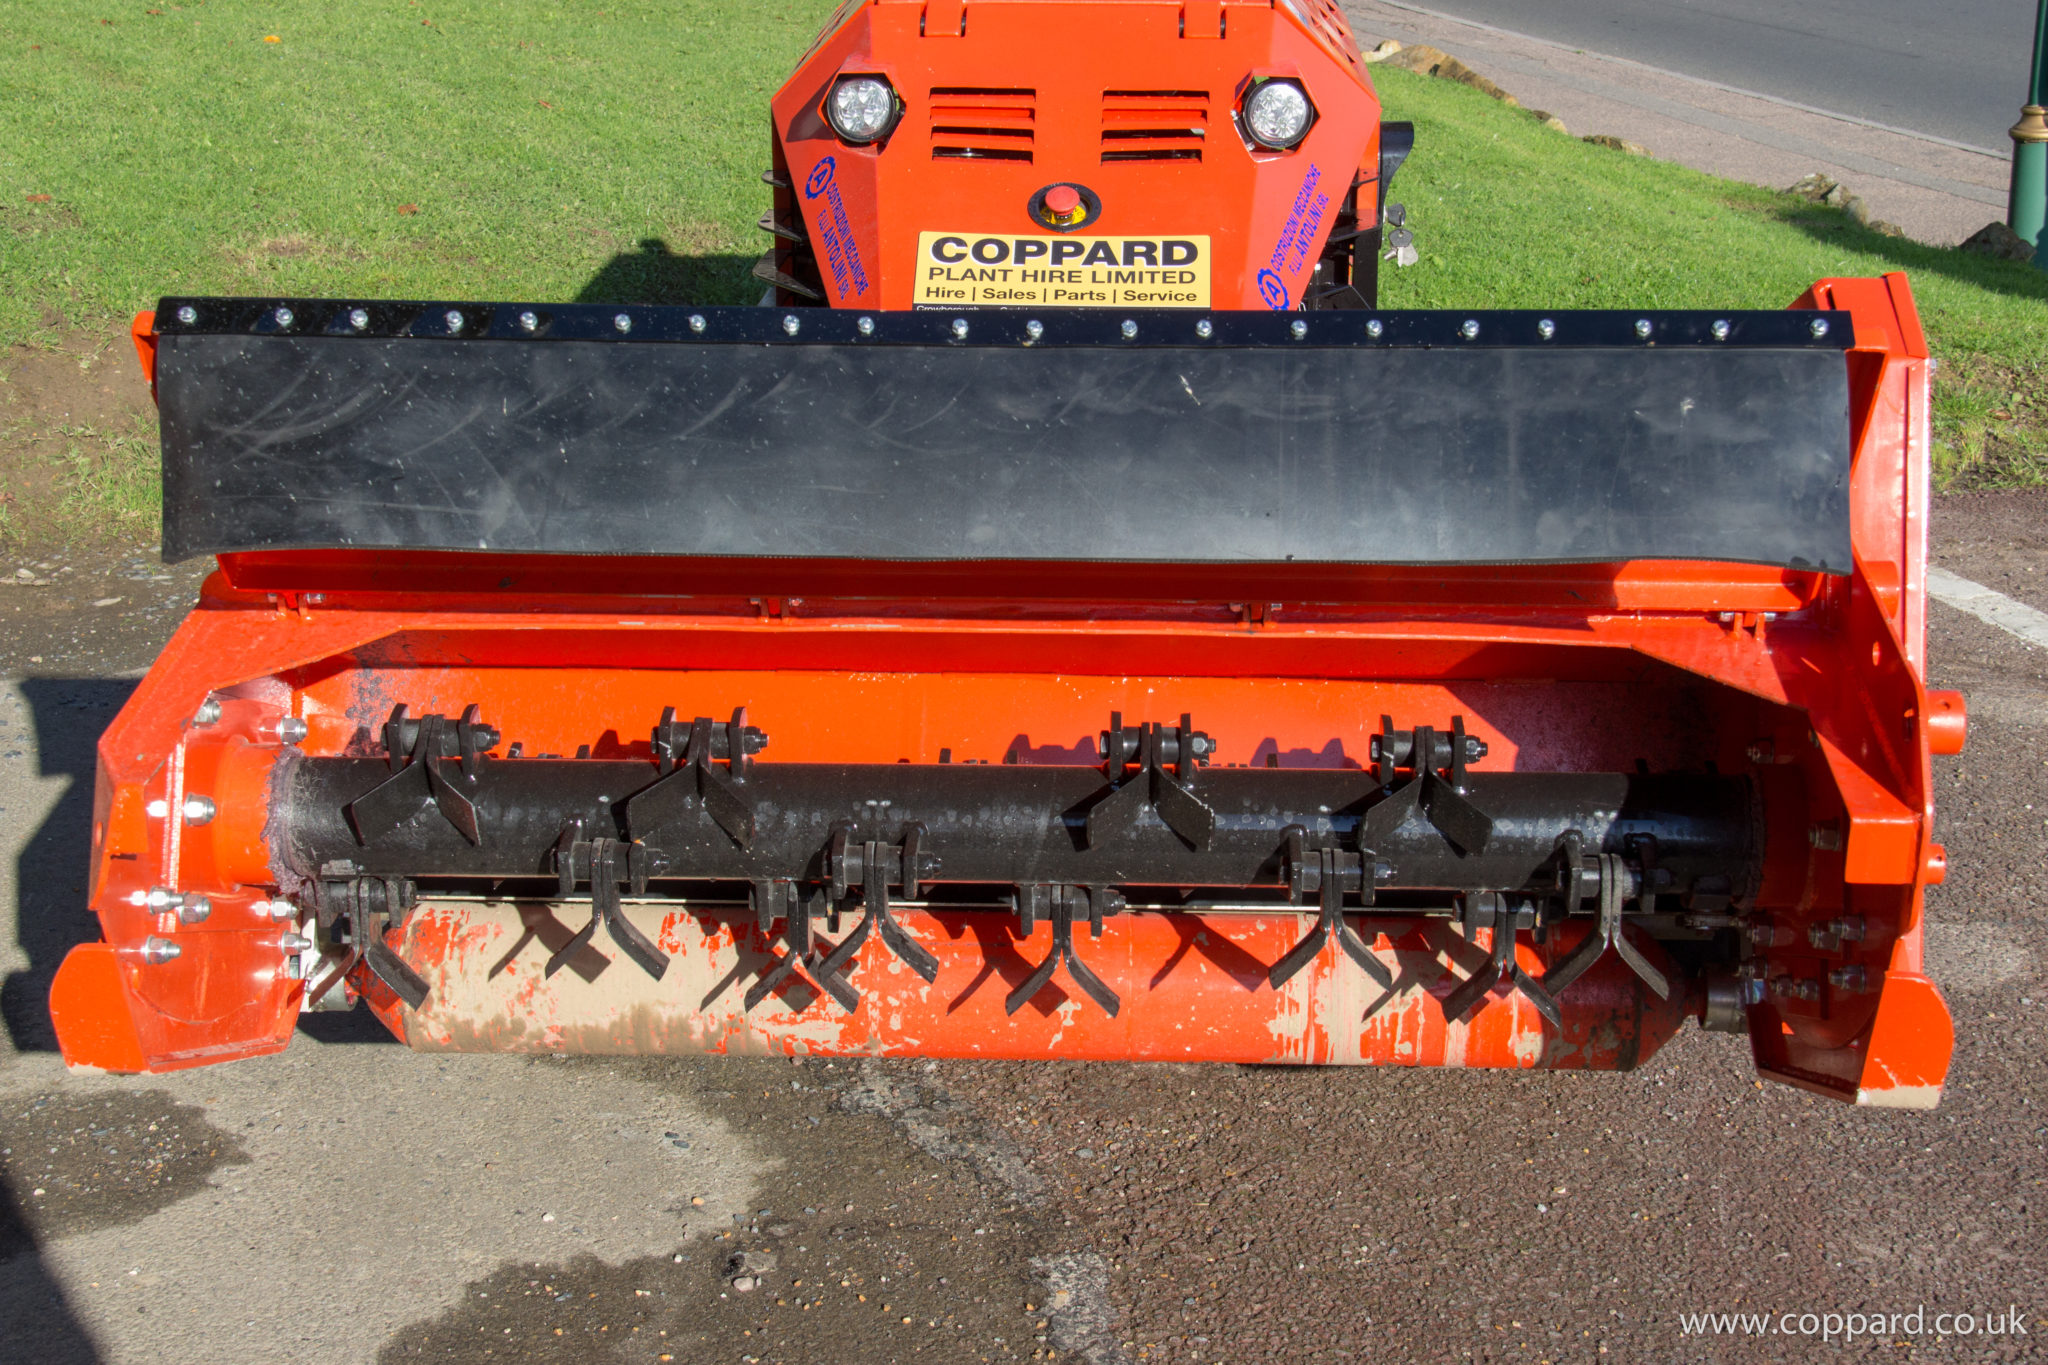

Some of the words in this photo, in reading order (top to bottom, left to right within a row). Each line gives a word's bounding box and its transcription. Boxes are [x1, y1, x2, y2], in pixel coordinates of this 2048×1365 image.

[827, 182, 851, 241] COSTRUZIONI
[842, 234, 869, 296] MECCANICHE
[1270, 216, 1299, 272] COSTRUZIONI
[1292, 164, 1321, 220] MECCANICHE
[1294, 202, 1326, 257] ANTOLINI
[823, 226, 848, 285] ANTOLINI
[928, 267, 1013, 282] PLANT
[1021, 269, 1083, 284] HIRE
[1091, 270, 1196, 285] LIMITED
[930, 236, 1199, 267] COPPARD
[926, 287, 966, 299] Hire
[982, 288, 1037, 300] Sales
[1054, 289, 1106, 302] Parts
[1123, 289, 1197, 302] Service
